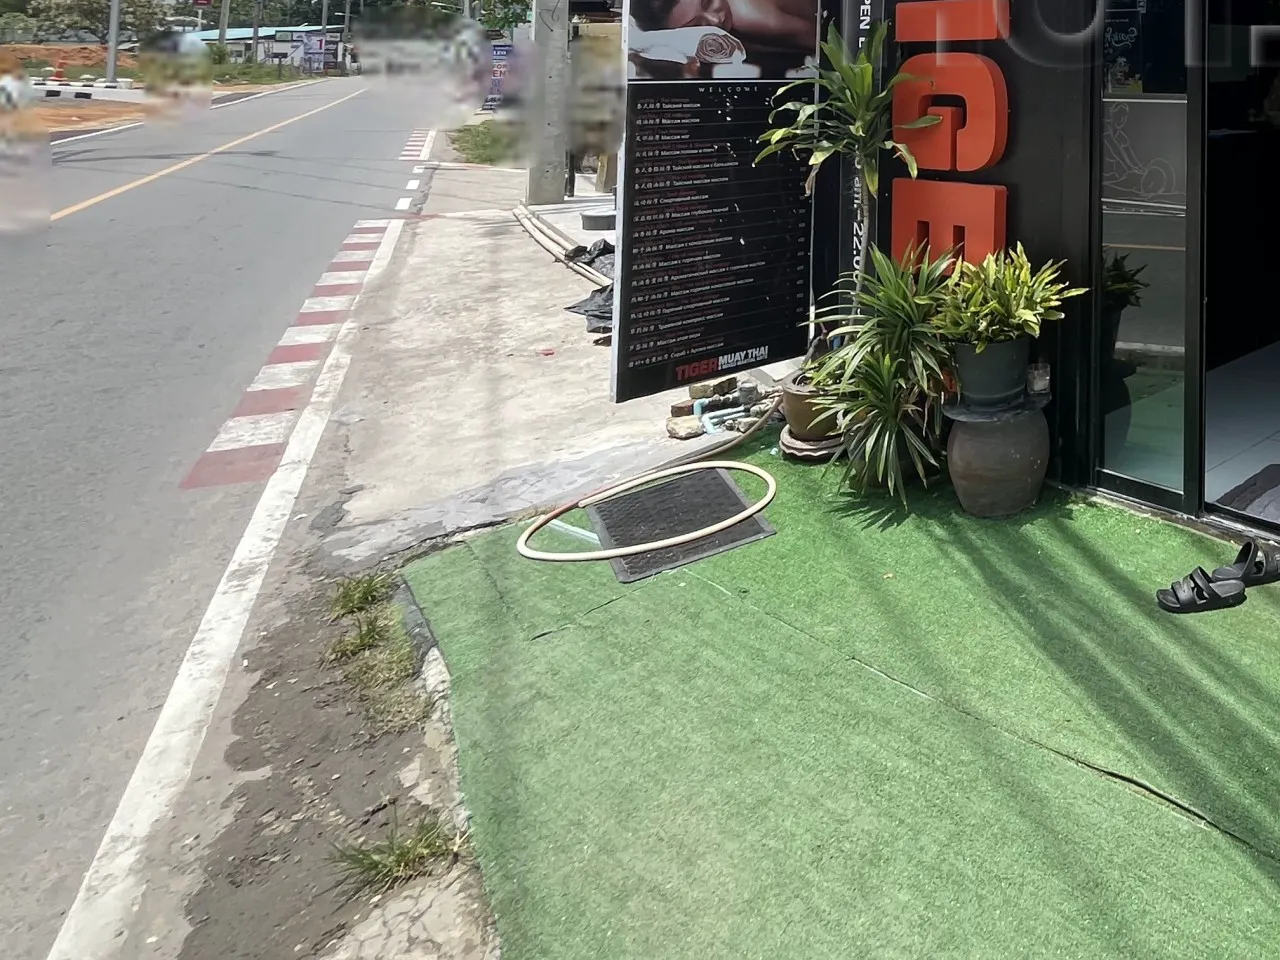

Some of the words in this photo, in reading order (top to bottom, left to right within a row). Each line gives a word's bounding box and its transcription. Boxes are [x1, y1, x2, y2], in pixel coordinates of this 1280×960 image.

[676, 357, 718, 381] TIGER
[718, 350, 747, 366] MUAY
[747, 345, 769, 359] THAI
